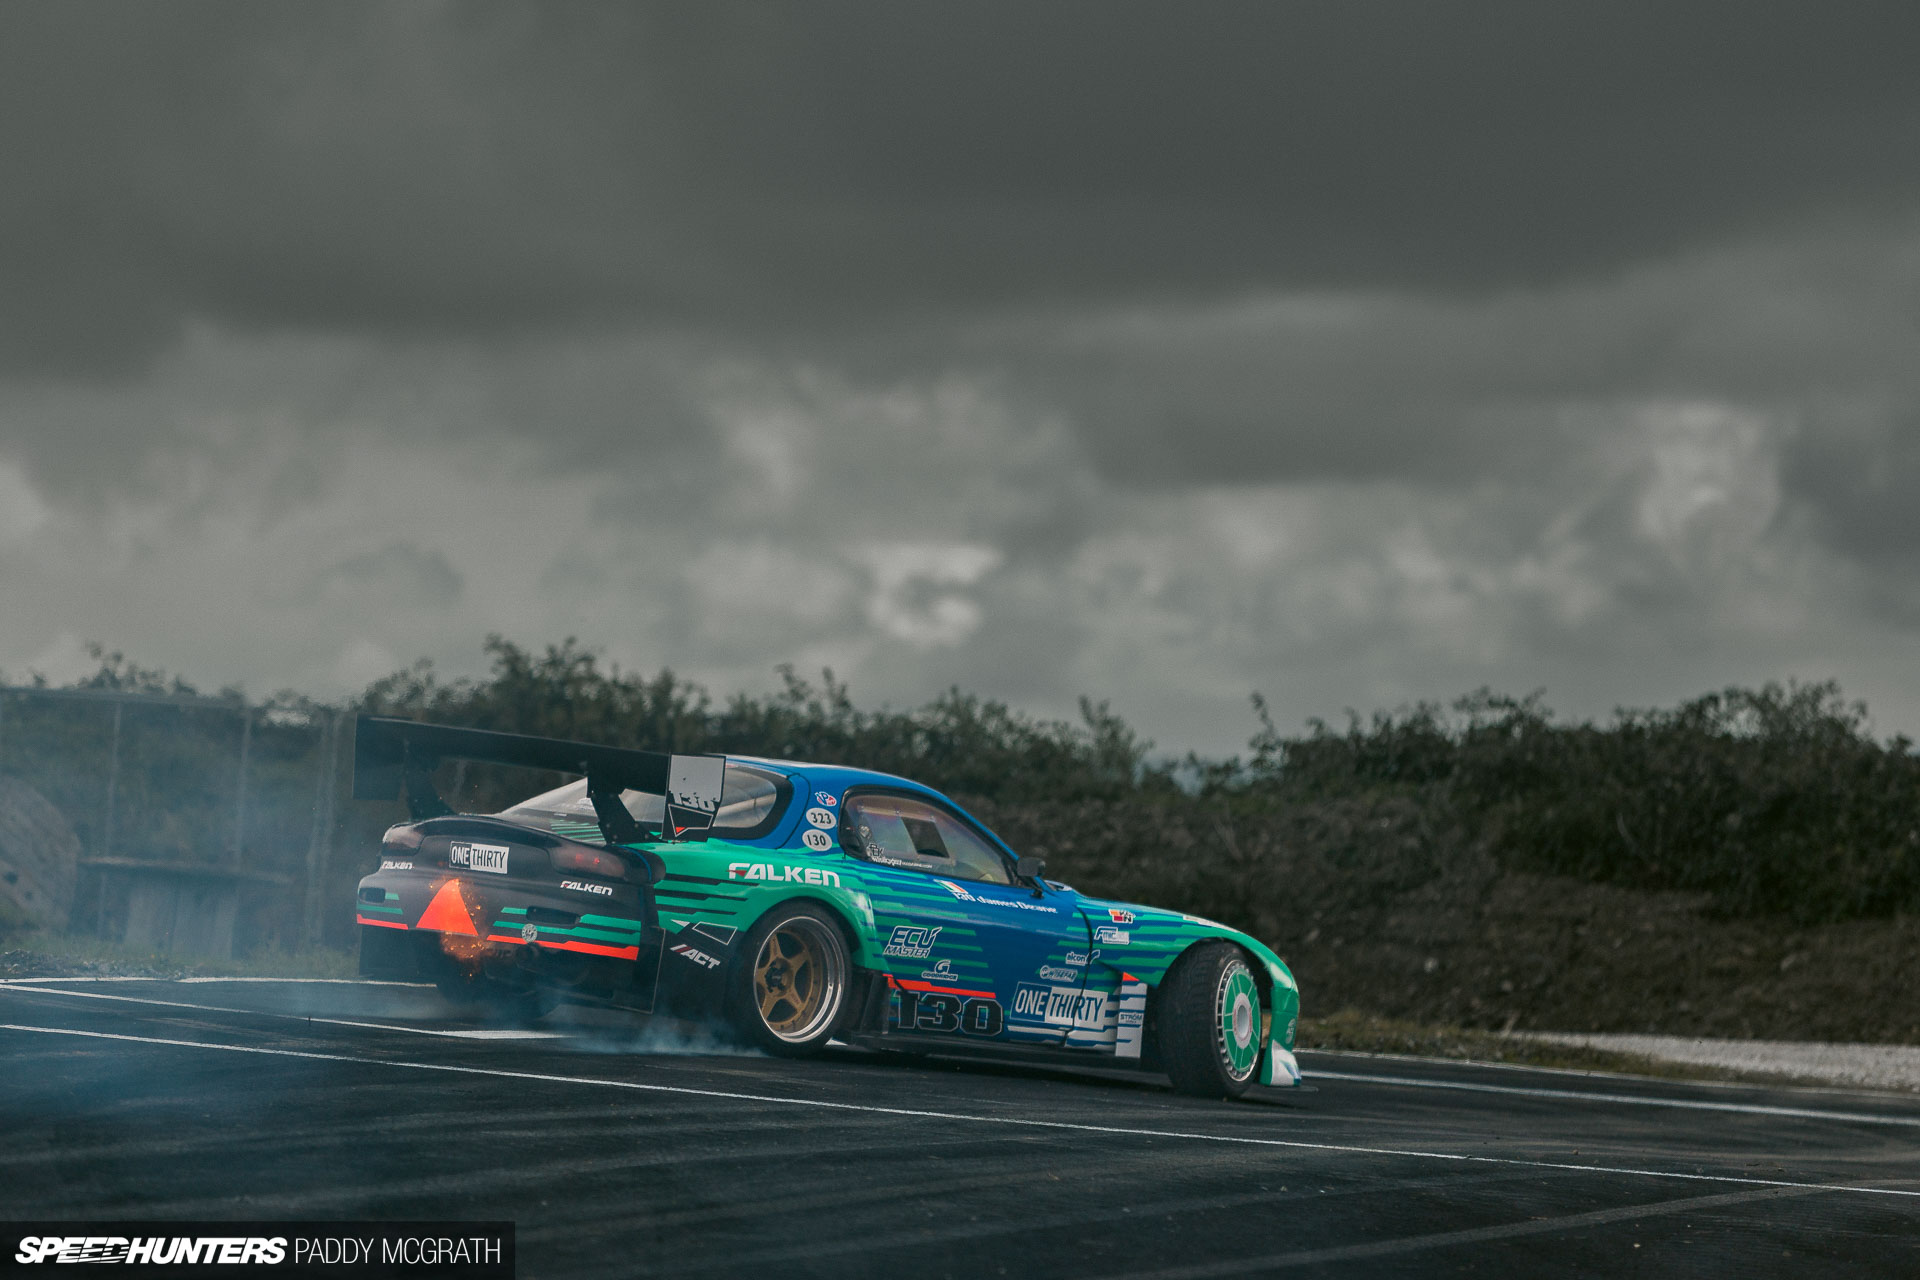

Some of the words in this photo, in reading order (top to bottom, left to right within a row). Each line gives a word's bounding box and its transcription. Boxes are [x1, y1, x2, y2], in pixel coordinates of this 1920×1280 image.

[810, 812, 832, 824] 323
[807, 834, 827, 847] 130
[381, 860, 413, 870] FALKEN
[451, 845, 470, 865] ONE
[472, 848, 506, 868] THIRTY
[727, 862, 841, 888] FALKEN
[560, 880, 613, 896] FALKEN
[888, 925, 943, 949] ECU
[883, 945, 930, 959] MASTER
[893, 990, 1003, 1036] 130
[1015, 989, 1048, 1016] ONE
[1049, 993, 1104, 1022] THIRTY
